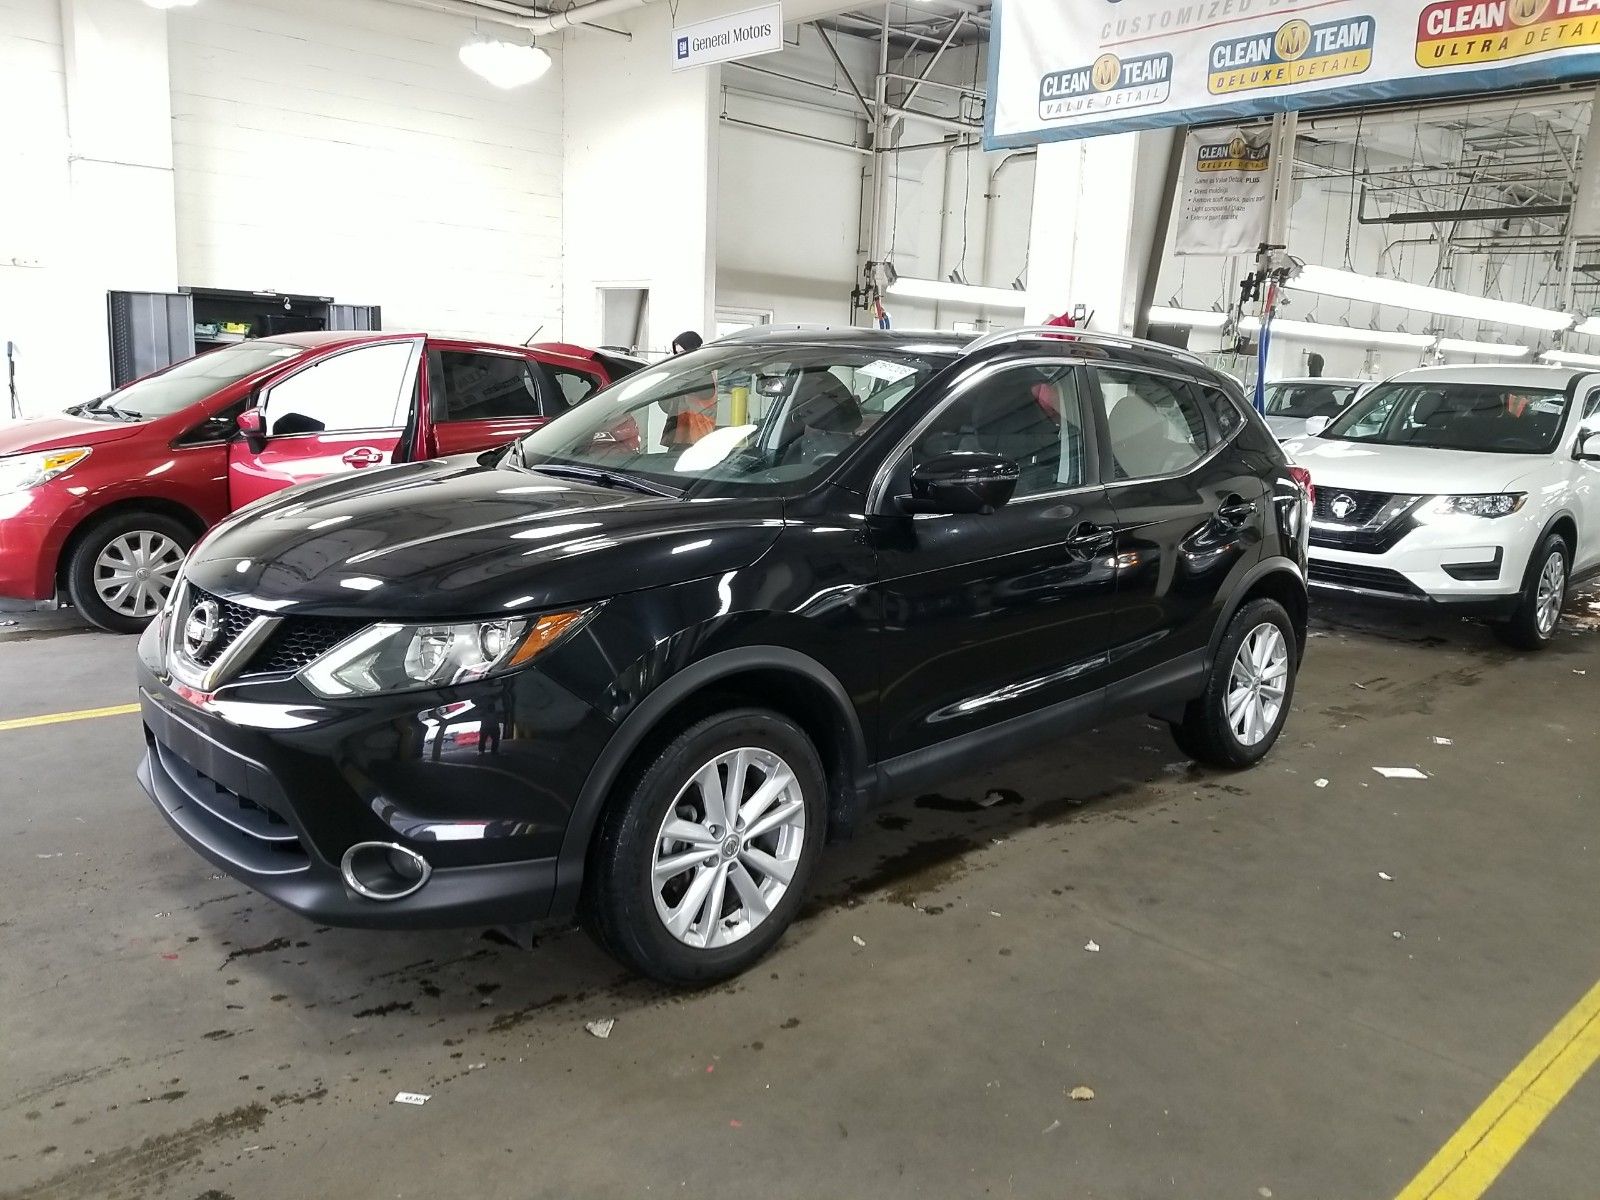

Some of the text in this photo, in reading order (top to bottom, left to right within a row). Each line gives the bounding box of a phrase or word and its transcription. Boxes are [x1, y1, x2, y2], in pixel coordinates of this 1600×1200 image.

[1101, 0, 1250, 39] CUSTOMIZED
[1427, 0, 1506, 36] CLEAN
[692, 23, 772, 52] General Motors
[1213, 37, 1272, 69] CLEAN
[1313, 20, 1370, 54] TEAM
[1434, 21, 1600, 58] ULTRA DETAI
[1042, 70, 1091, 97] CLEAN
[1122, 57, 1169, 85] TEAM
[1216, 55, 1360, 88] DELUXE DETAIL
[1046, 87, 1160, 114] VALUE DETAIL
[1200, 145, 1229, 159] CLEAN
[1245, 176, 1260, 184] PLUS
